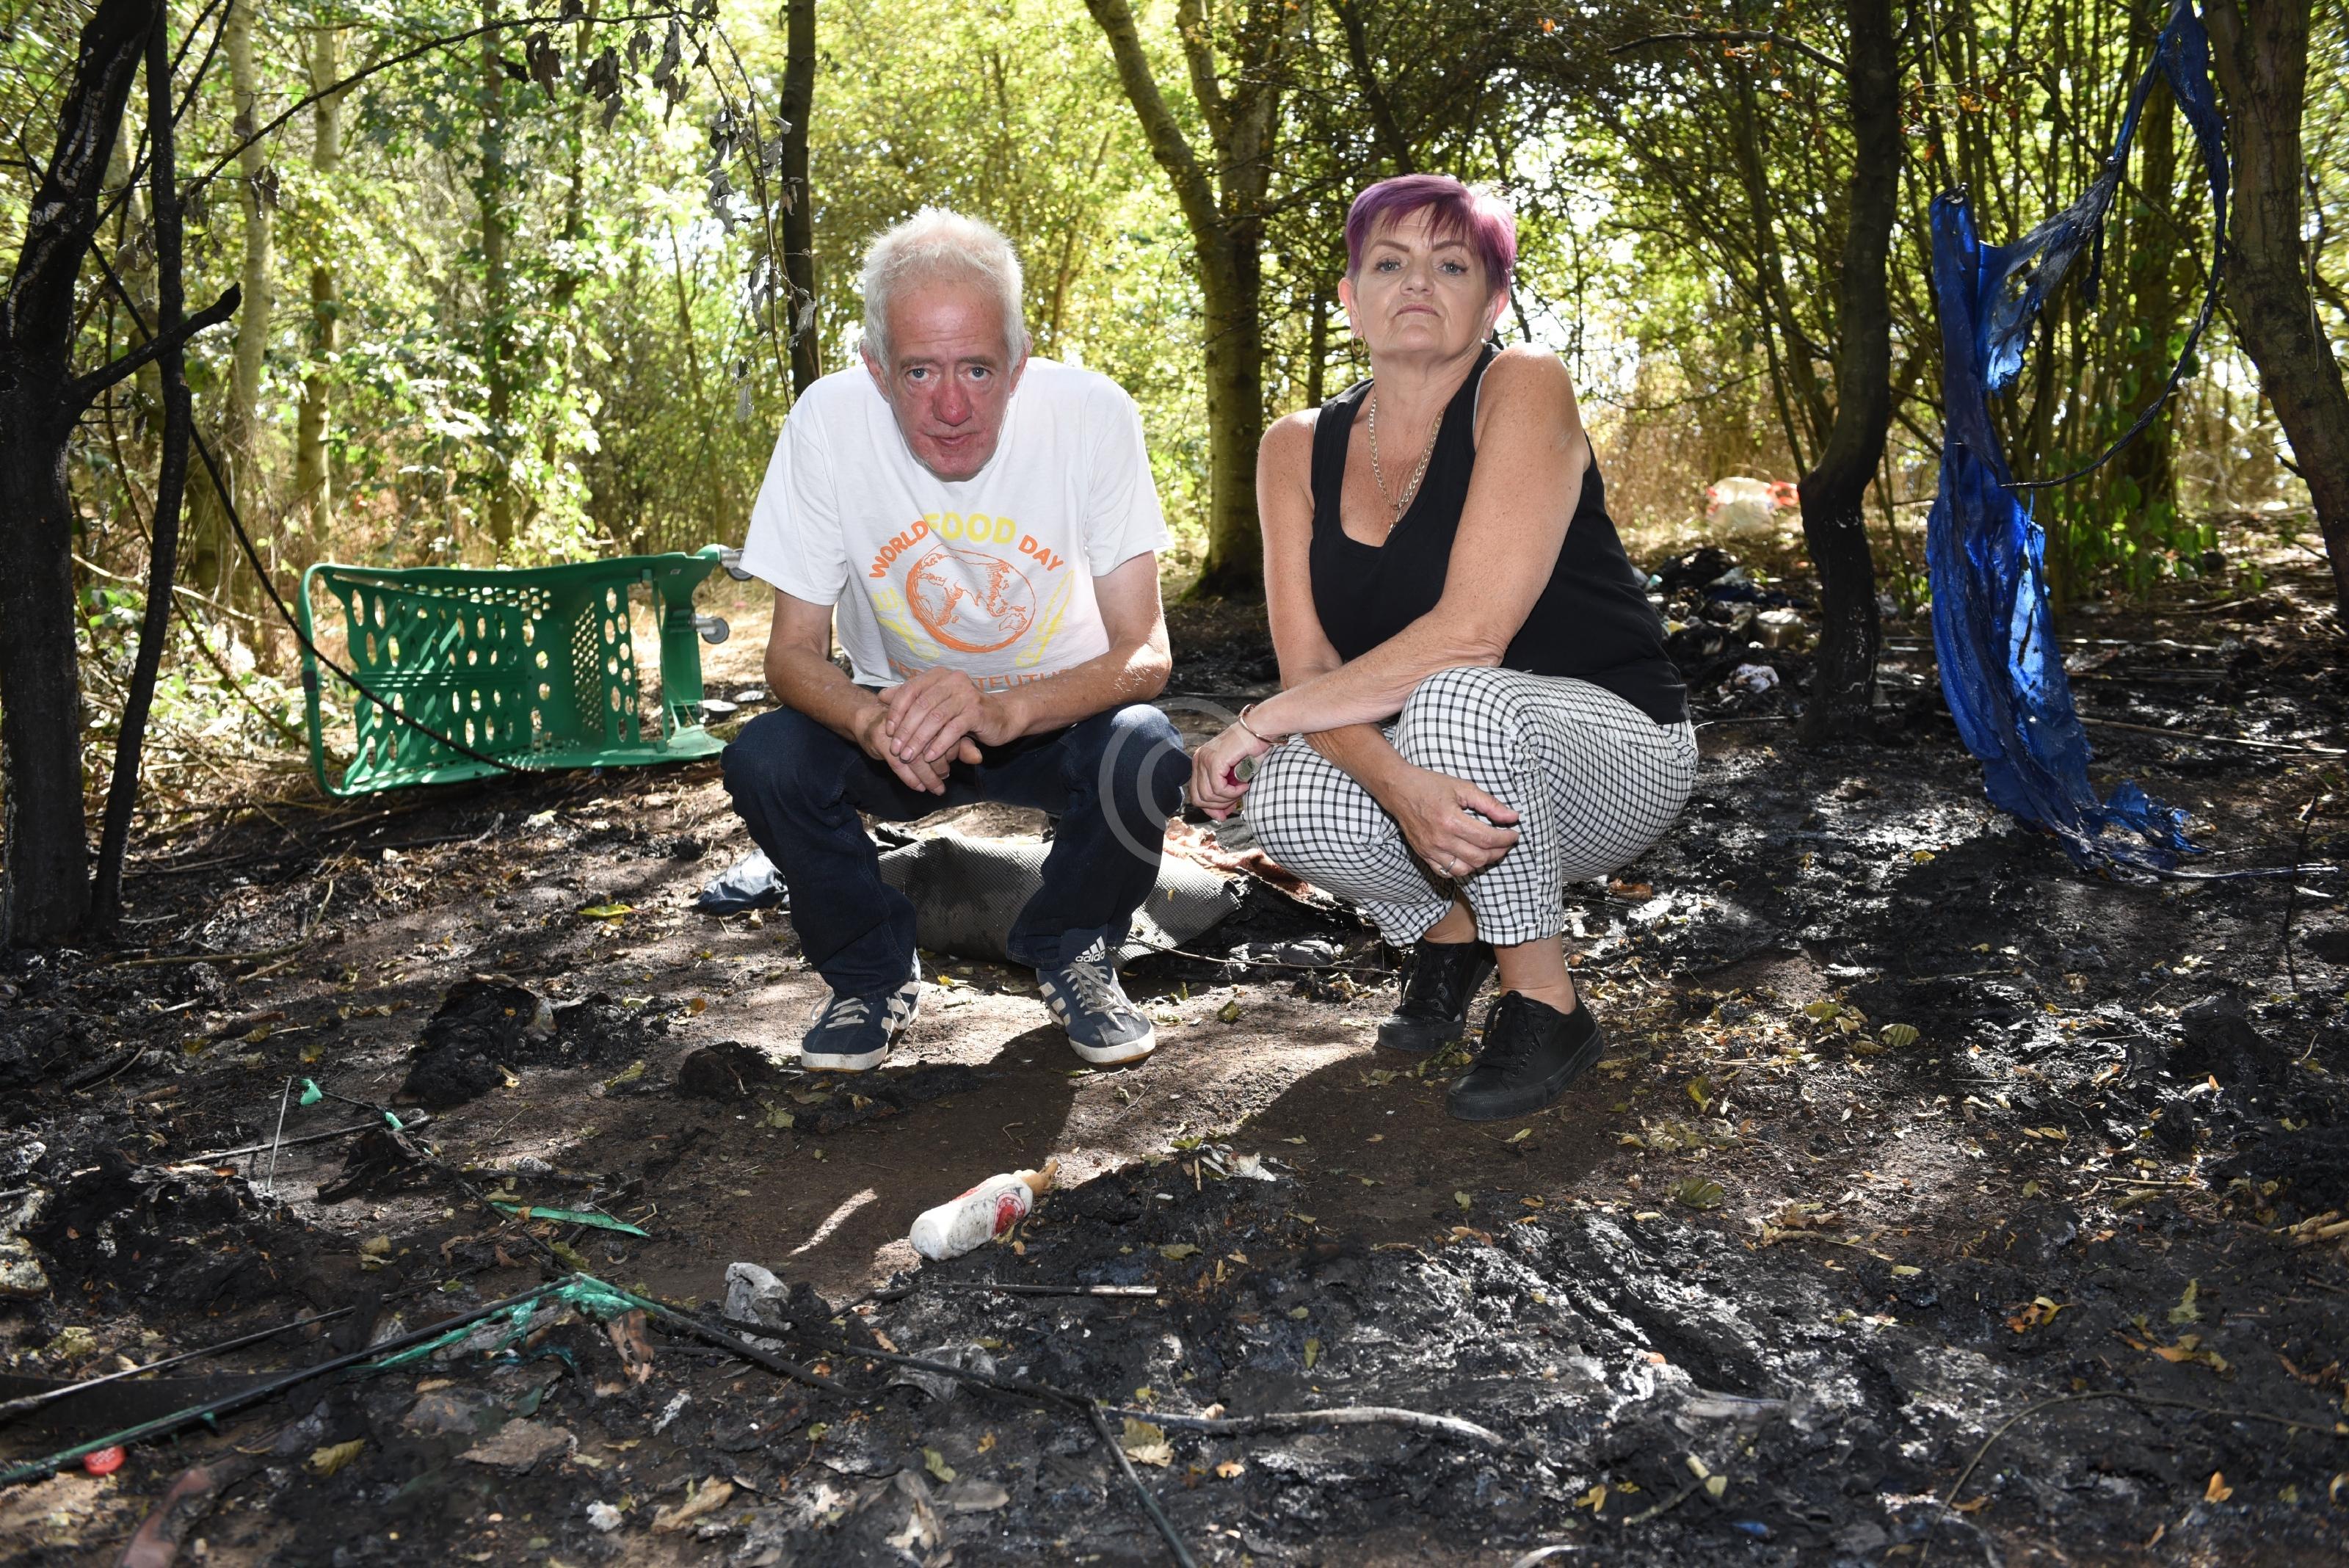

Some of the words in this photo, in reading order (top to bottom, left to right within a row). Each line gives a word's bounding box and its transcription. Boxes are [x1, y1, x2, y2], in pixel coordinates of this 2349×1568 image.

[869, 520, 929, 578] WORLD
[924, 511, 1016, 545] FOOD
[1018, 534, 1064, 571] DAY
[1075, 950, 1105, 962] adida
